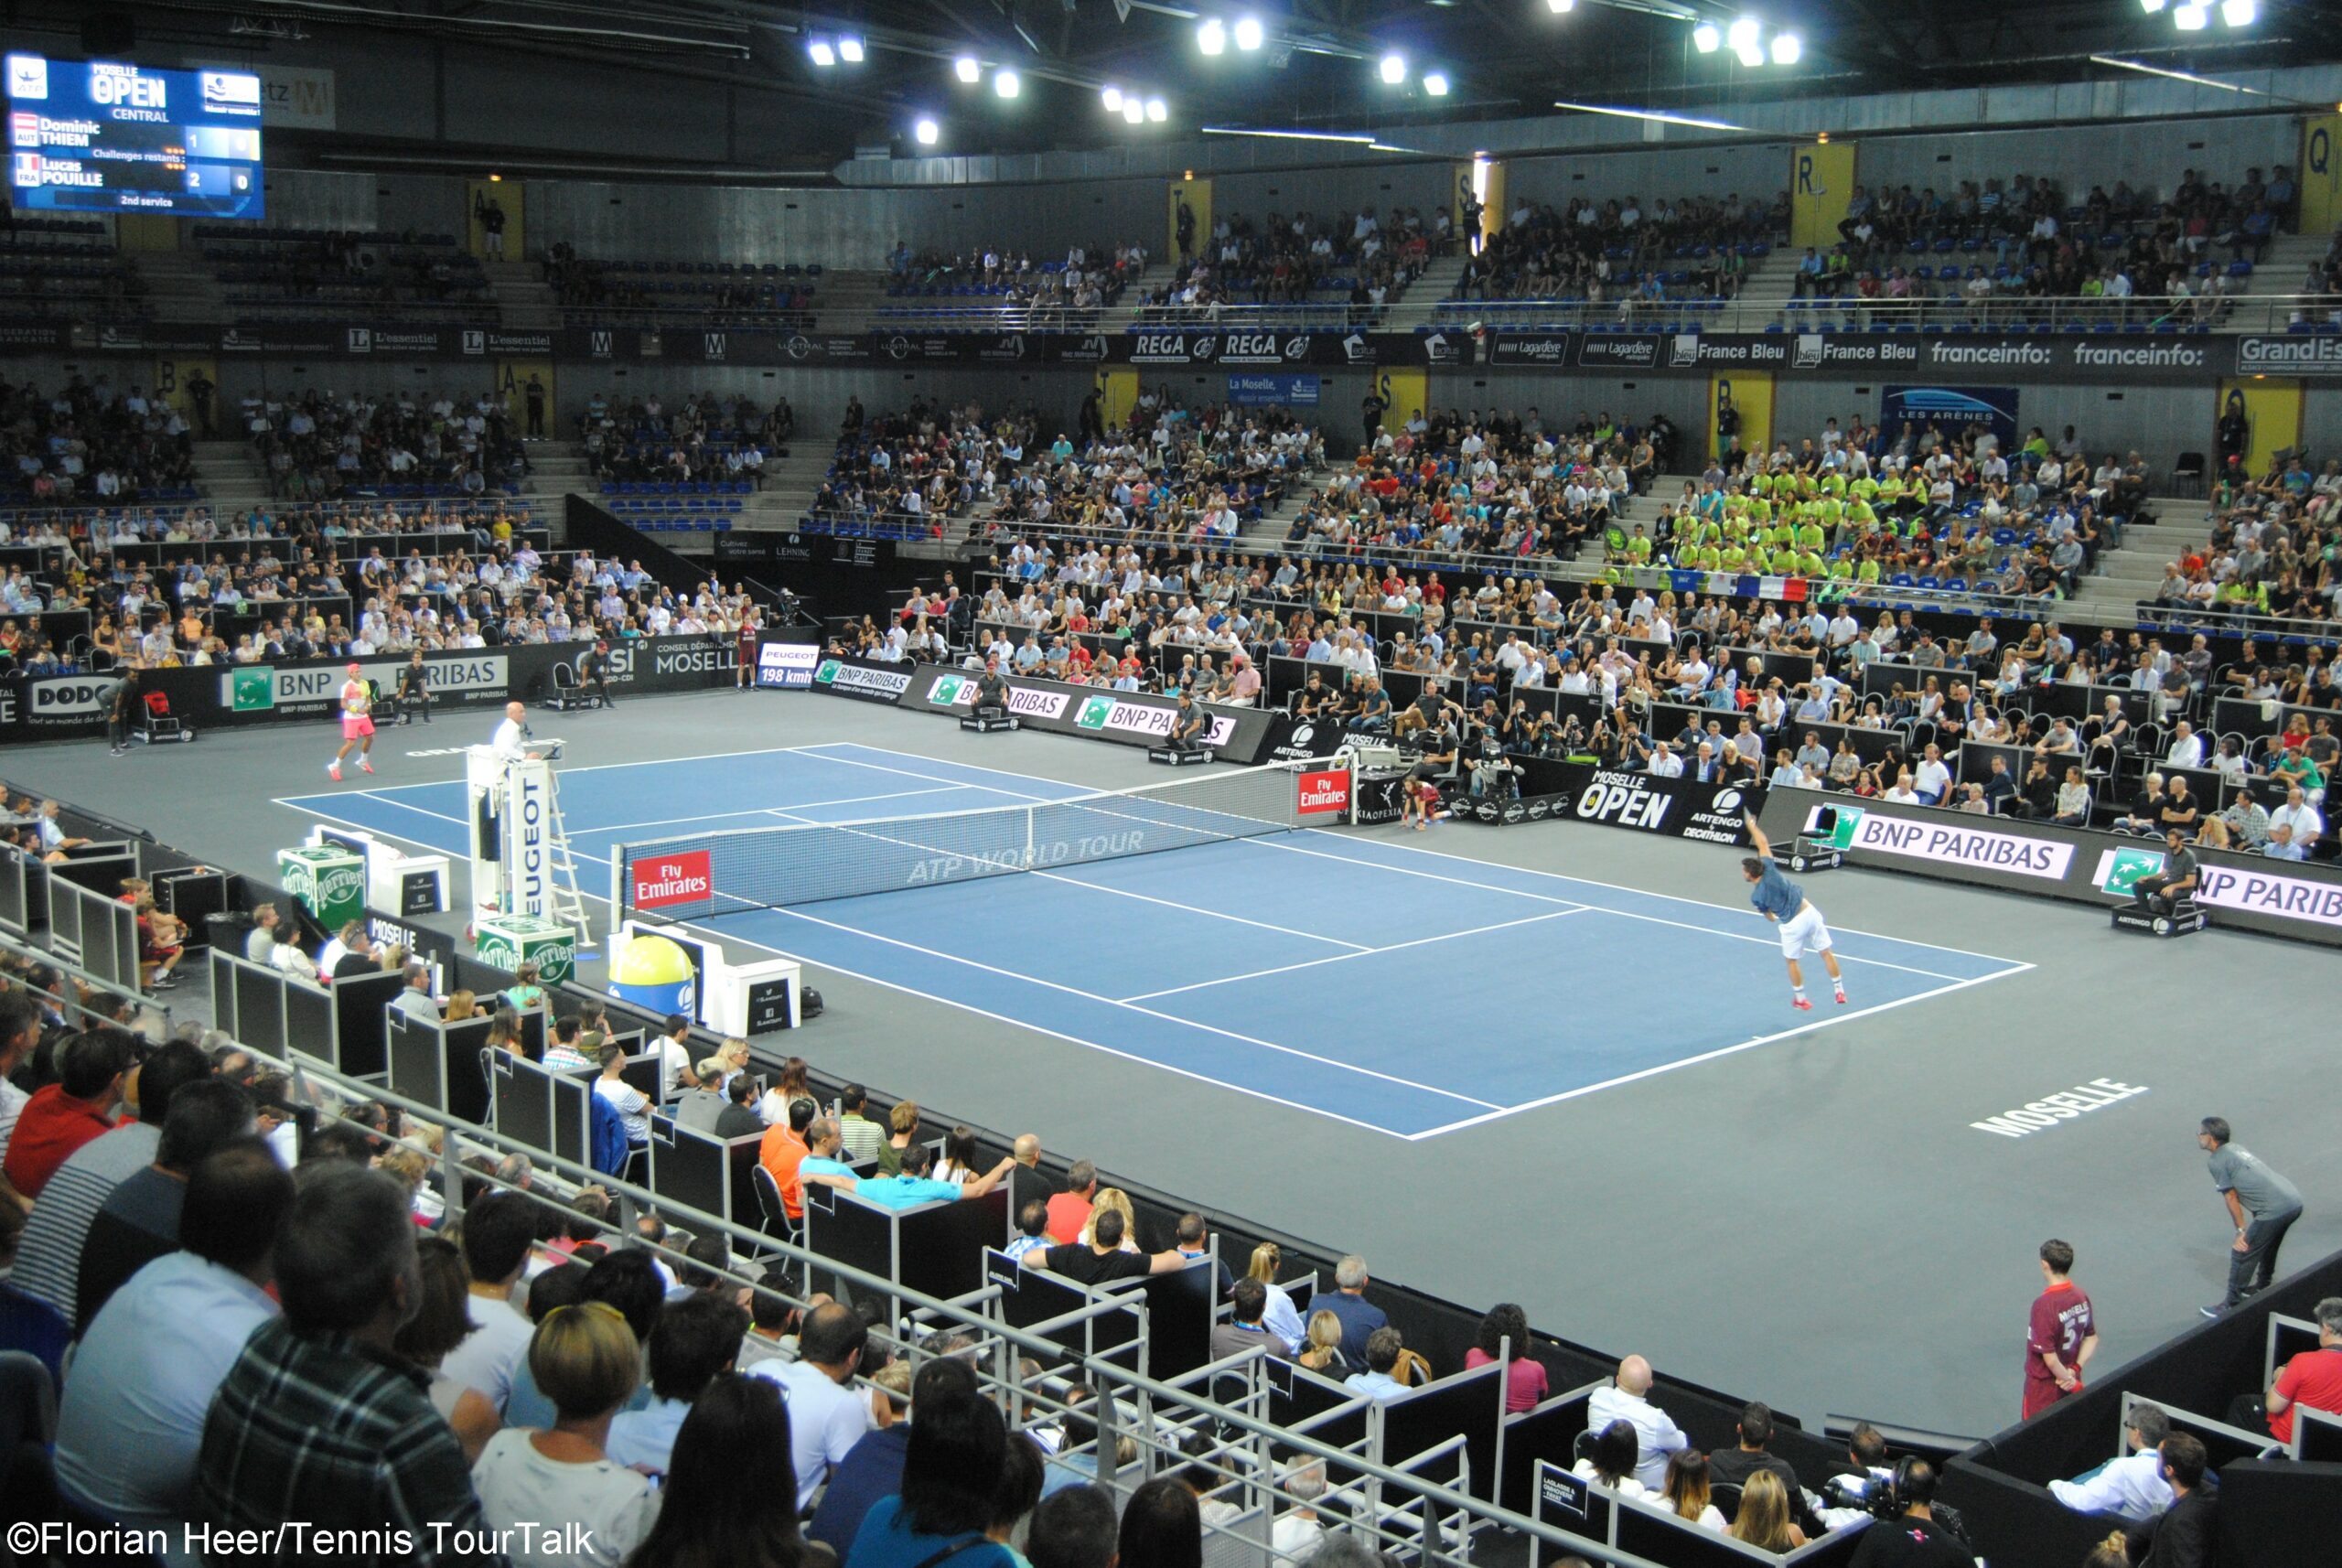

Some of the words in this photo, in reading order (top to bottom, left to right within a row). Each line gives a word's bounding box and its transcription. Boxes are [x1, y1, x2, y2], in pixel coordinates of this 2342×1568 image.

[92, 74, 166, 108] OPEN
[113, 109, 169, 123] CENTRAL
[40, 117, 101, 134] Dominic
[17, 134, 35, 142] AUT
[40, 132, 89, 146] THIEM
[190, 135, 198, 147] 1
[93, 149, 142, 161] Challenges
[145, 154, 179, 163] restants
[2310, 128, 2329, 175] Q
[42, 157, 81, 172] Lucas
[19, 174, 37, 182] FRA
[42, 171, 102, 187] POUILLE
[190, 173, 199, 187] 2
[238, 176, 248, 189] 0
[1799, 156, 1813, 194] R
[122, 196, 139, 206] 2nd
[141, 197, 173, 207] service
[489, 335, 551, 347] L'essentiel
[1136, 335, 1185, 354] REGA
[1226, 334, 1276, 354] REGA
[1520, 339, 1562, 355] Lagardère
[1609, 341, 1652, 357] Lagardère
[1676, 349, 1696, 360] bleu
[1698, 343, 1747, 360] France
[1751, 343, 1784, 360] Bleu
[1799, 350, 1821, 361] bleu
[1823, 343, 1875, 360] France
[1881, 344, 1916, 360] Bleu
[1931, 341, 2051, 364] franceinfo:
[2074, 342, 2204, 366] franceinfo:
[502, 364, 517, 396] A
[1230, 379, 1240, 391] La
[1242, 378, 1276, 392] Moselle,
[1899, 411, 1926, 419] LES
[1932, 411, 1993, 421] ARÈNES
[720, 540, 747, 548] Cultivez
[777, 547, 810, 557] LEHNING
[658, 644, 689, 653] CONSEIL
[767, 651, 815, 660] PEUGEOT
[762, 669, 783, 682] 198
[786, 670, 812, 684] kmh
[838, 668, 861, 682] BNP
[861, 672, 907, 690] PARIBAS
[280, 672, 331, 697] BNP
[837, 683, 851, 693] banque
[486, 690, 509, 698] PARIBAS
[301, 703, 328, 712] PARIBAS
[57, 714, 81, 725] monde
[1112, 707, 1148, 727] BNP
[1342, 733, 1387, 746] MOSELLE
[1273, 746, 1314, 758] ARTENGO
[1317, 779, 1331, 789] Fly
[1592, 769, 1646, 790] MOSELLE
[1301, 790, 1346, 807] Emirates
[1576, 783, 1671, 829] OPEN
[1372, 807, 1402, 820] OPEXIA
[1691, 812, 1743, 828] ARTENGO
[1683, 827, 1736, 844] DECATHLON
[523, 778, 542, 917] EUGEOT
[1863, 820, 1923, 849] BNP
[1927, 830, 2055, 871] PARIBAS
[907, 857, 962, 883] ATP
[972, 840, 1069, 874] WORLD
[1078, 830, 1144, 858] TOUR
[661, 865, 682, 878] Fly
[638, 876, 707, 900] Emirates
[2118, 916, 2151, 928] ARTENGO
[372, 918, 416, 952] MOSELLE
[1969, 1078, 2149, 1138] MOSELLE
